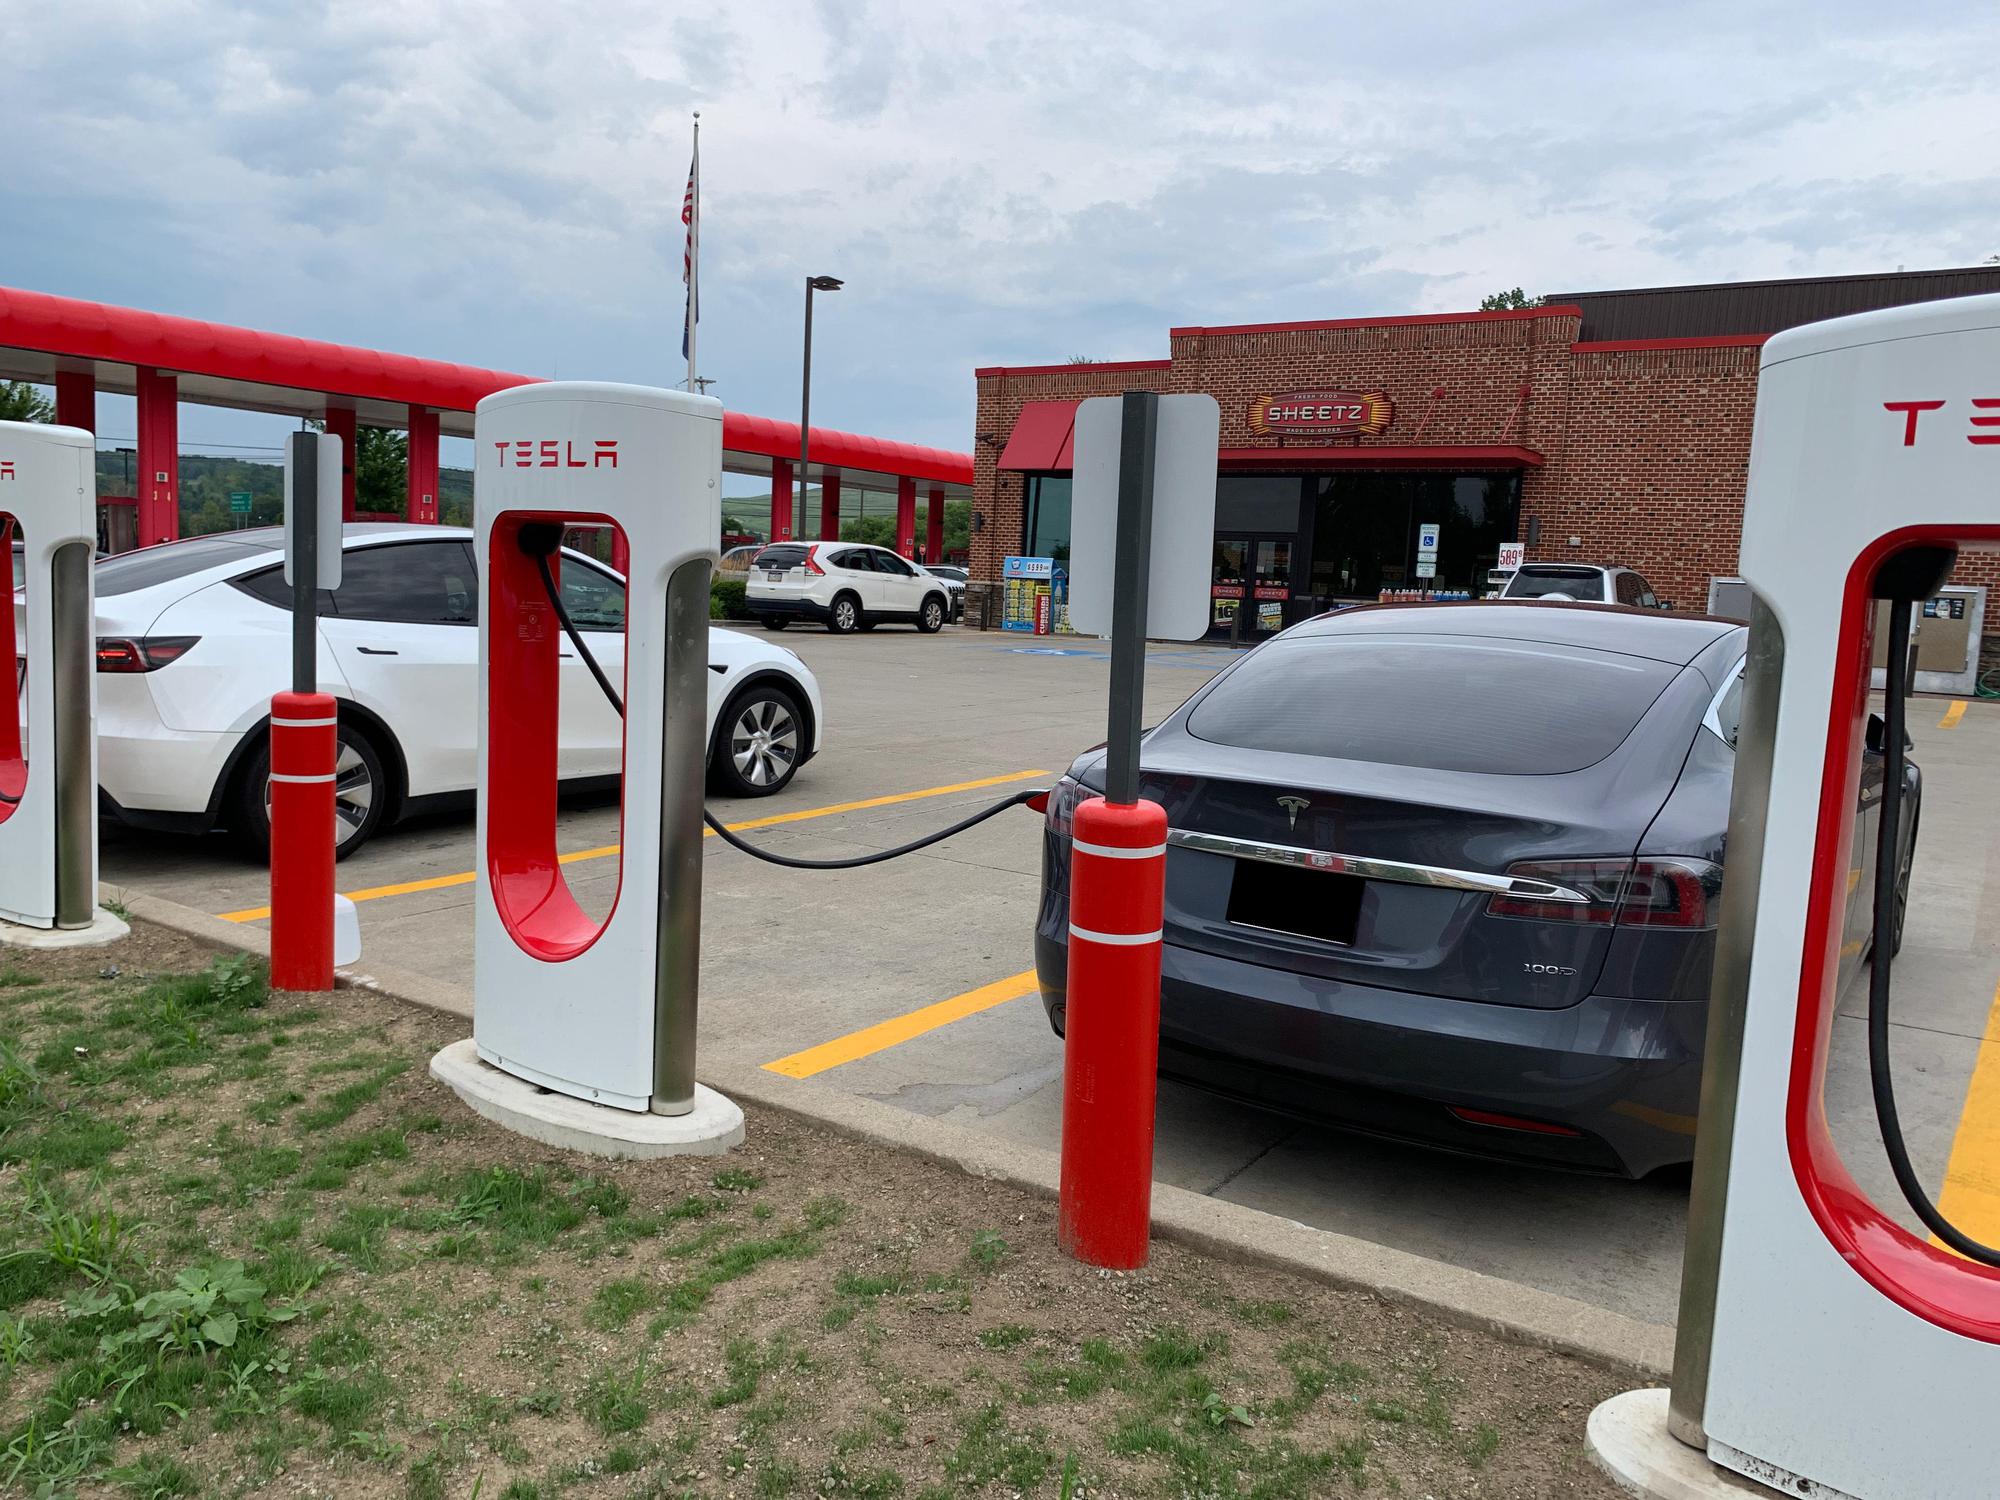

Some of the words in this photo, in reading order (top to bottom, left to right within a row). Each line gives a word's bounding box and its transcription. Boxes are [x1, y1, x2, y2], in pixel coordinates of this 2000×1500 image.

[1268, 405, 1362, 421] SHEETZ
[495, 441, 618, 468] TESLA
[1230, 842, 1358, 873] TESA
[1523, 963, 1577, 975] 100D
